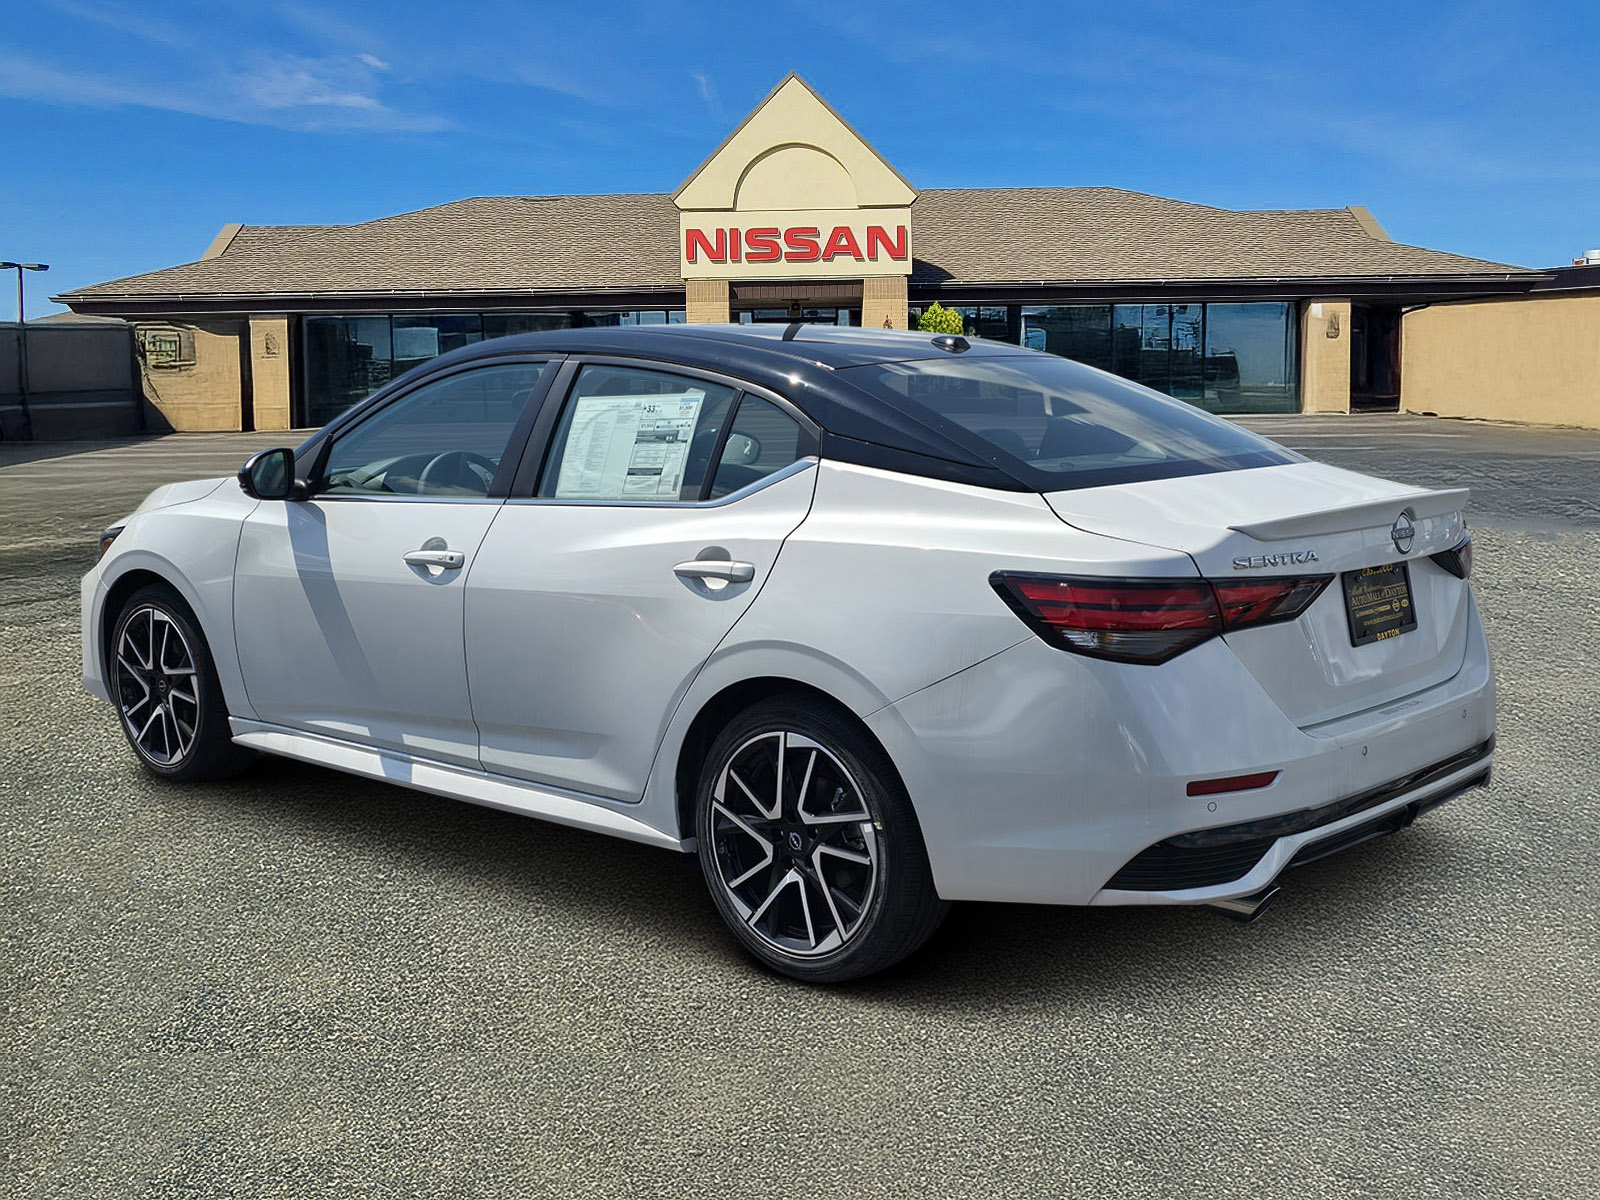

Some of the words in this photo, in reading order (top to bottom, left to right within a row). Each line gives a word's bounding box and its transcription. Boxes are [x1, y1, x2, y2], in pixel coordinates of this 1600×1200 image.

[686, 225, 906, 263] NISSAN
[1392, 528, 1413, 539] NISS
[1232, 550, 1319, 570] SENTRA
[1376, 628, 1400, 640] DAYTON
